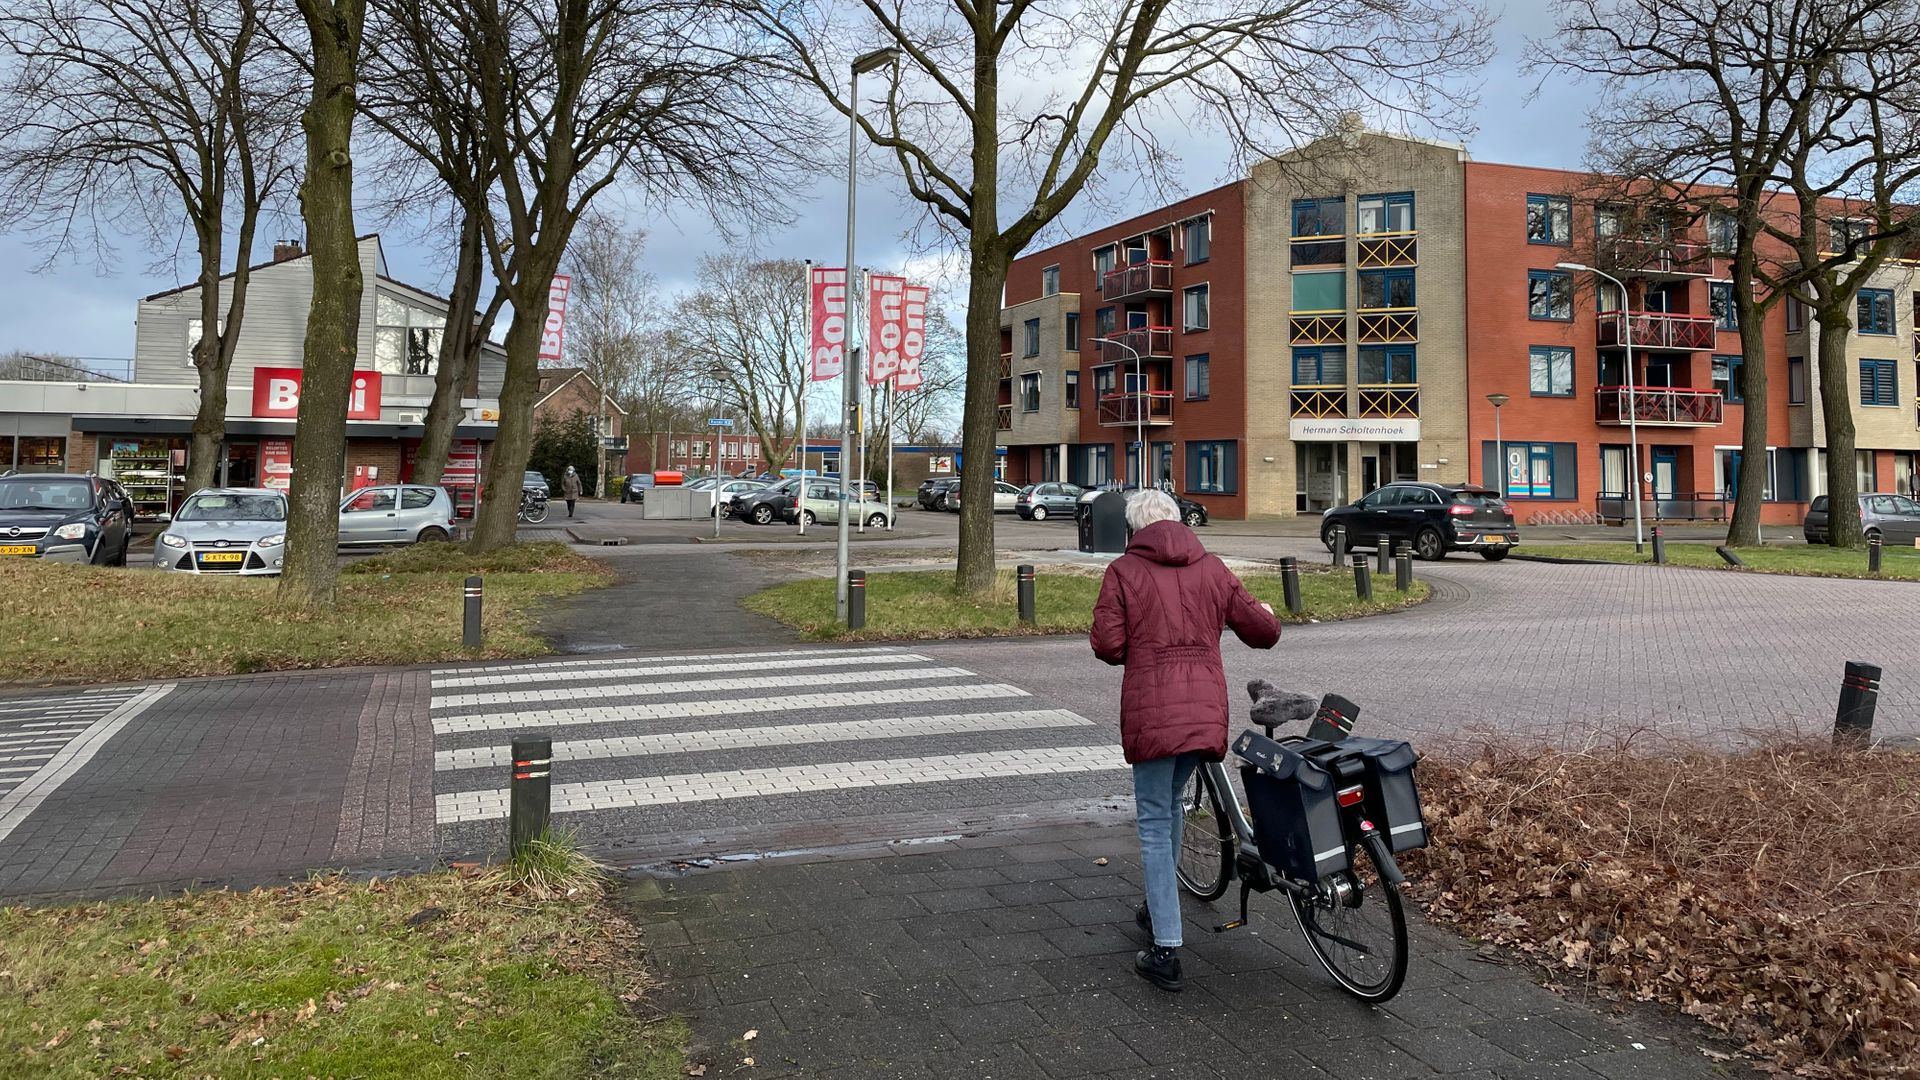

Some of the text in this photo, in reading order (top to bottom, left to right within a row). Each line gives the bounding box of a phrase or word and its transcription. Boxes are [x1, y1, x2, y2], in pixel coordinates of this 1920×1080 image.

[540, 278, 568, 355] Boni
[814, 271, 846, 376] Boni
[873, 279, 903, 379] Boni
[898, 290, 926, 385] Boni
[269, 378, 366, 412] Bi
[1303, 426, 1404, 434] Herman Scholtenhoek
